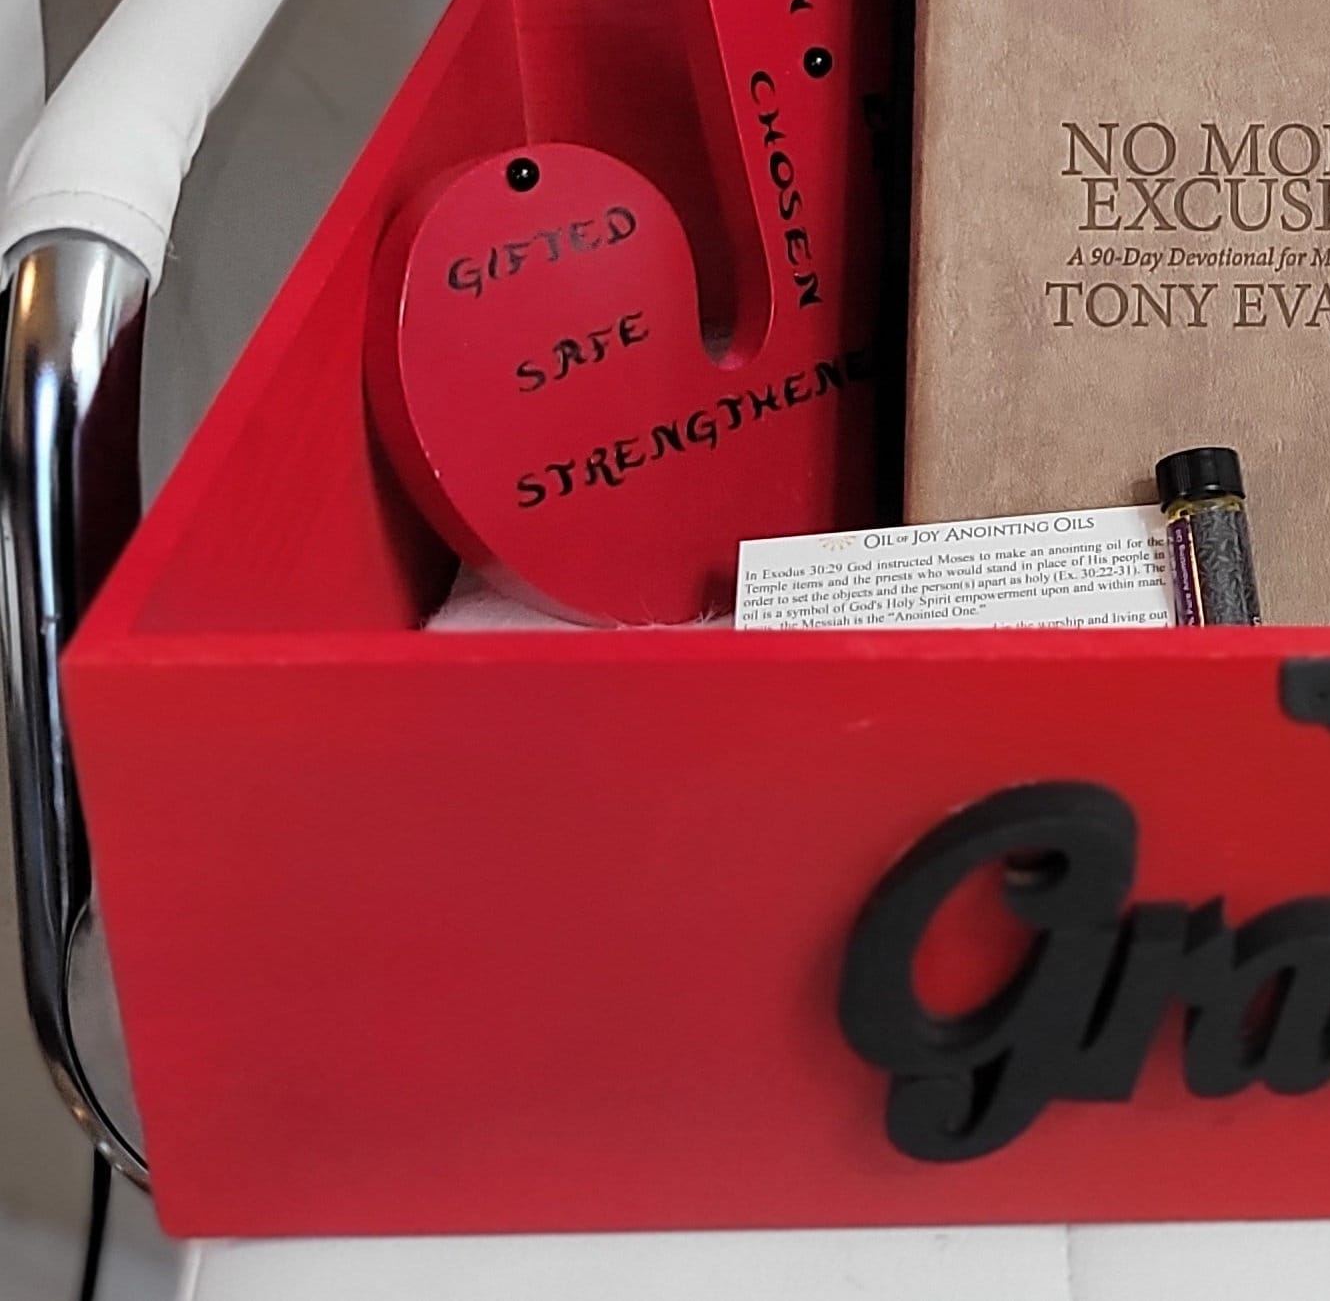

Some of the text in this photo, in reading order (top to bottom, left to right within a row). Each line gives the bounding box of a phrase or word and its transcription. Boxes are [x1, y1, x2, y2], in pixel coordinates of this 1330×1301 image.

[1061, 122, 1177, 177] NO
[750, 70, 823, 309] CHOSEN
[447, 205, 637, 299] GIFTED
[1067, 248, 1084, 267] A
[1090, 248, 1163, 273] 90-Day
[1168, 247, 1274, 268] Devotional
[1274, 247, 1307, 273] for
[1045, 281, 1219, 328] TONY
[515, 311, 650, 393] SAFE
[745, 537, 1164, 581] In Exodus 30:29 God instructed Moses to make an anointing oil for the
[745, 550, 1165, 595] Temple items and the priests who would stand in place of His people in
[743, 596, 774, 608] order
[777, 595, 789, 605] to
[792, 593, 808, 603] set
[811, 590, 830, 601] the
[832, 587, 874, 601] objects
[876, 585, 897, 596] and
[901, 583, 918, 594] the
[921, 578, 975, 597] person(s)
[978, 576, 1007, 591] apart
[1010, 576, 1022, 585] as
[1025, 572, 1051, 586] holy
[1053, 569, 1078, 583] (Ex.
[1143, 563, 1166, 575] The
[743, 610, 759, 621] oil
[763, 608, 772, 619] is
[775, 610, 783, 619] a
[786, 604, 829, 620] symbol
[833, 602, 846, 614] of
[849, 599, 883, 612] God's
[887, 597, 915, 611] Holy
[919, 593, 951, 609] Spirit
[955, 588, 1037, 604] empowerment
[1041, 585, 1070, 598] upon
[1073, 582, 1094, 594] and
[1098, 578, 1134, 591] within
[801, 615, 850, 629] Messiah
[854, 614, 863, 625] is
[867, 612, 885, 624] the
[1087, 613, 1109, 626] and
[1112, 610, 1146, 625] living
[1149, 610, 1168, 620] out
